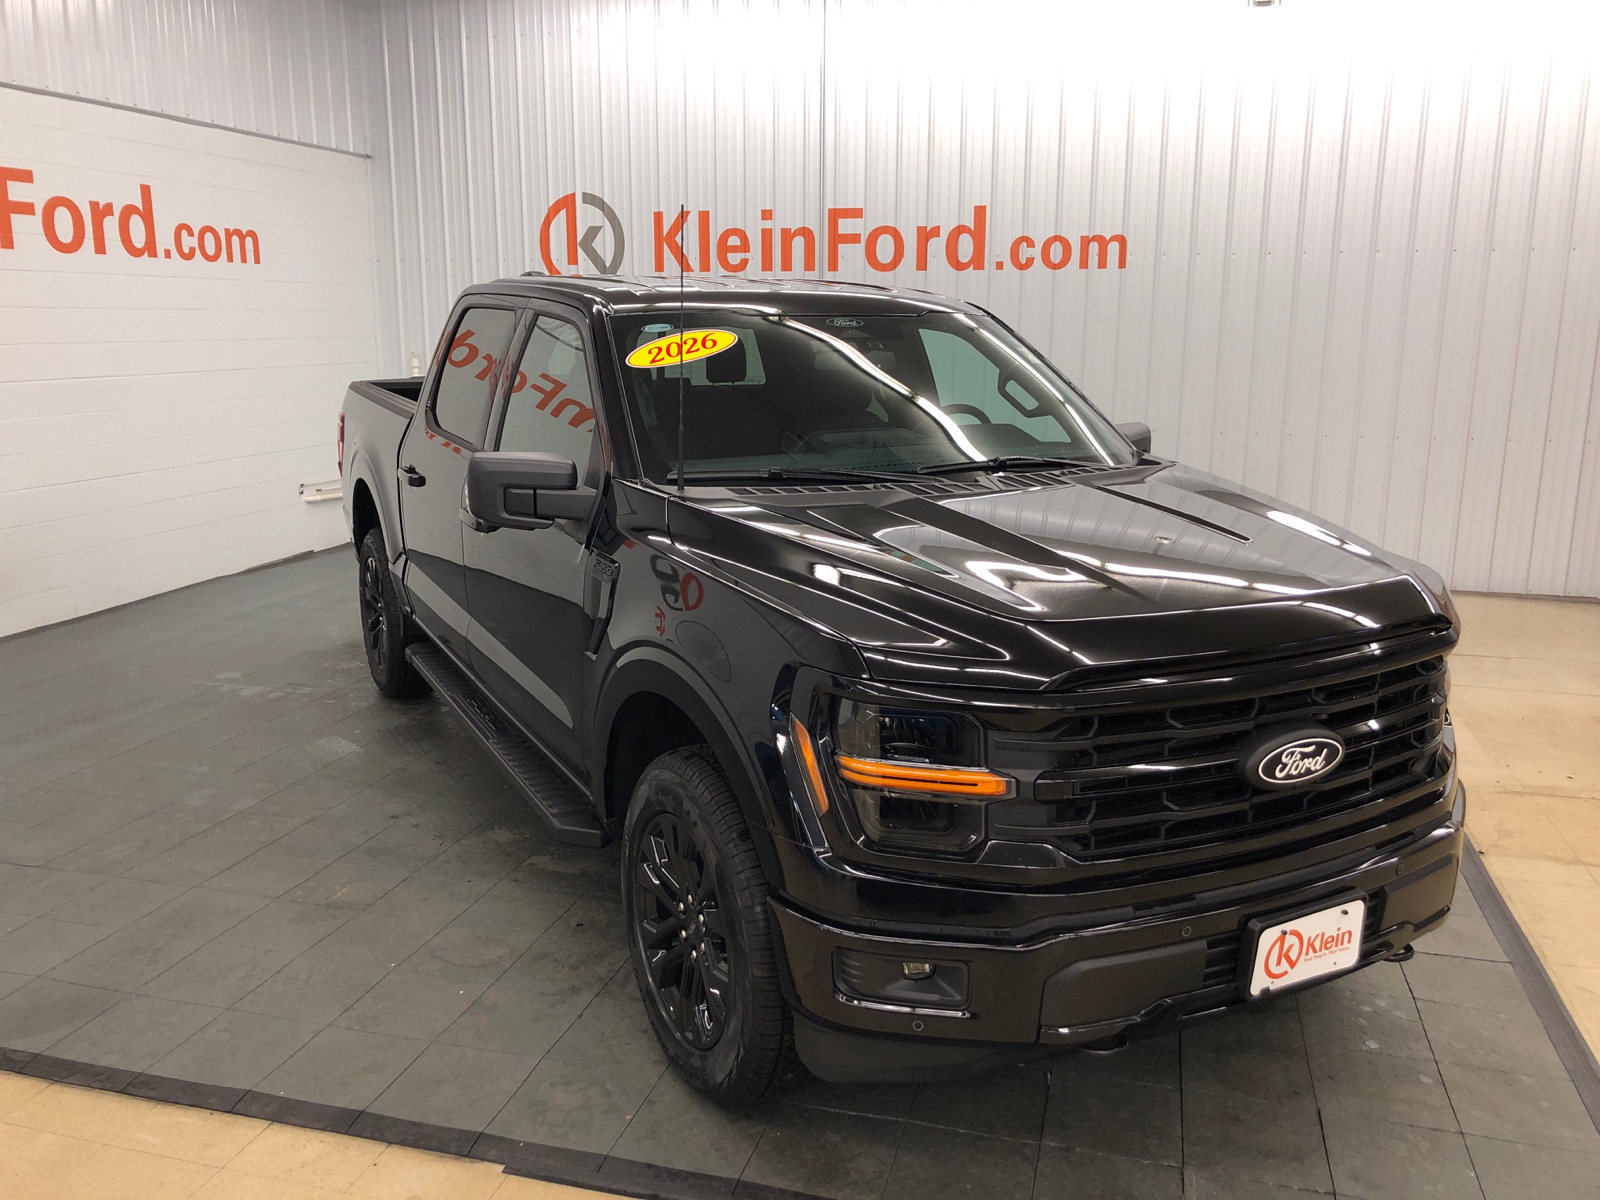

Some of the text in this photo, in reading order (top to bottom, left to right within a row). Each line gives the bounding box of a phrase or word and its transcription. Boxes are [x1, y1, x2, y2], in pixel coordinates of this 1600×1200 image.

[653, 204, 1129, 272] KleinFord.com
[647, 332, 718, 364] 2026
[1275, 744, 1328, 778] Ford
[1305, 927, 1353, 957] Klein
